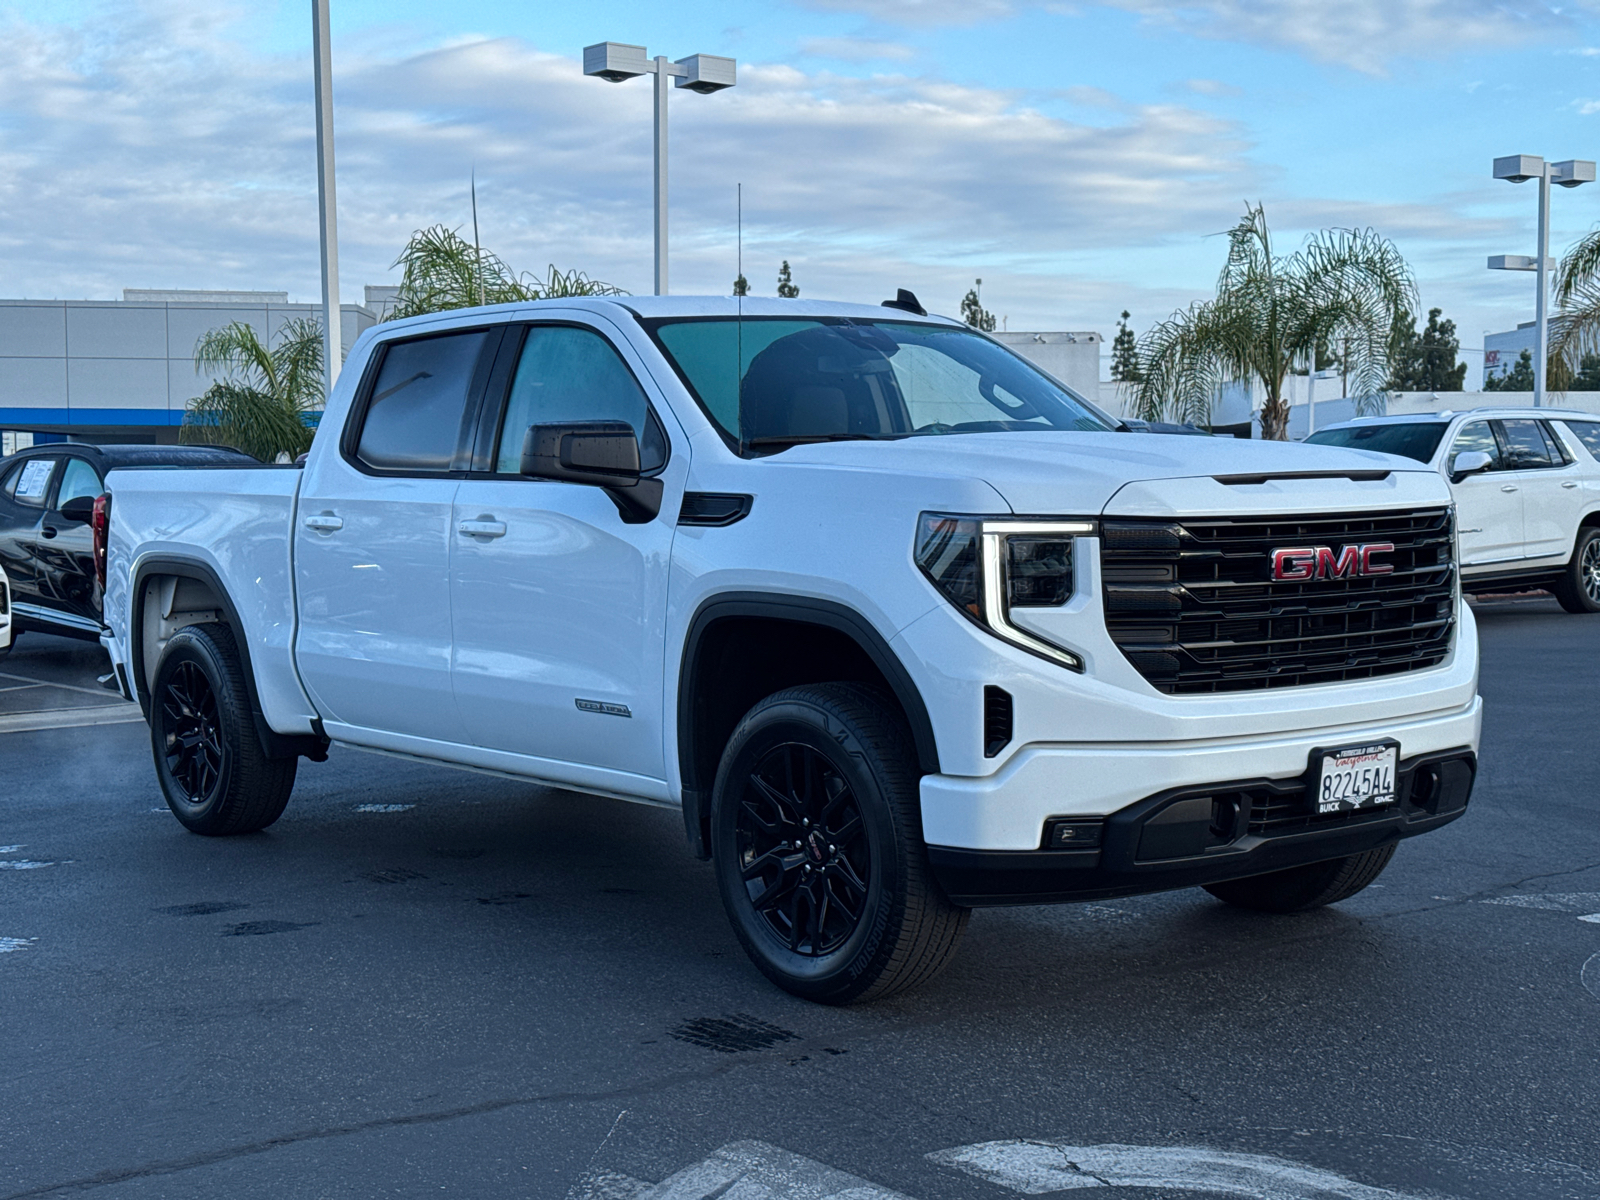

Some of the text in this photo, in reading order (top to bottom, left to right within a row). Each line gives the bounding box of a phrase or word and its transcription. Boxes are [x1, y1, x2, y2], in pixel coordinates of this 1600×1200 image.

[1271, 543, 1395, 581] GMC
[1322, 766, 1391, 801] 82245A4
[1374, 794, 1395, 804] GMC
[1319, 801, 1341, 813] BUICK
[848, 888, 894, 981] BRIDGESTONE
